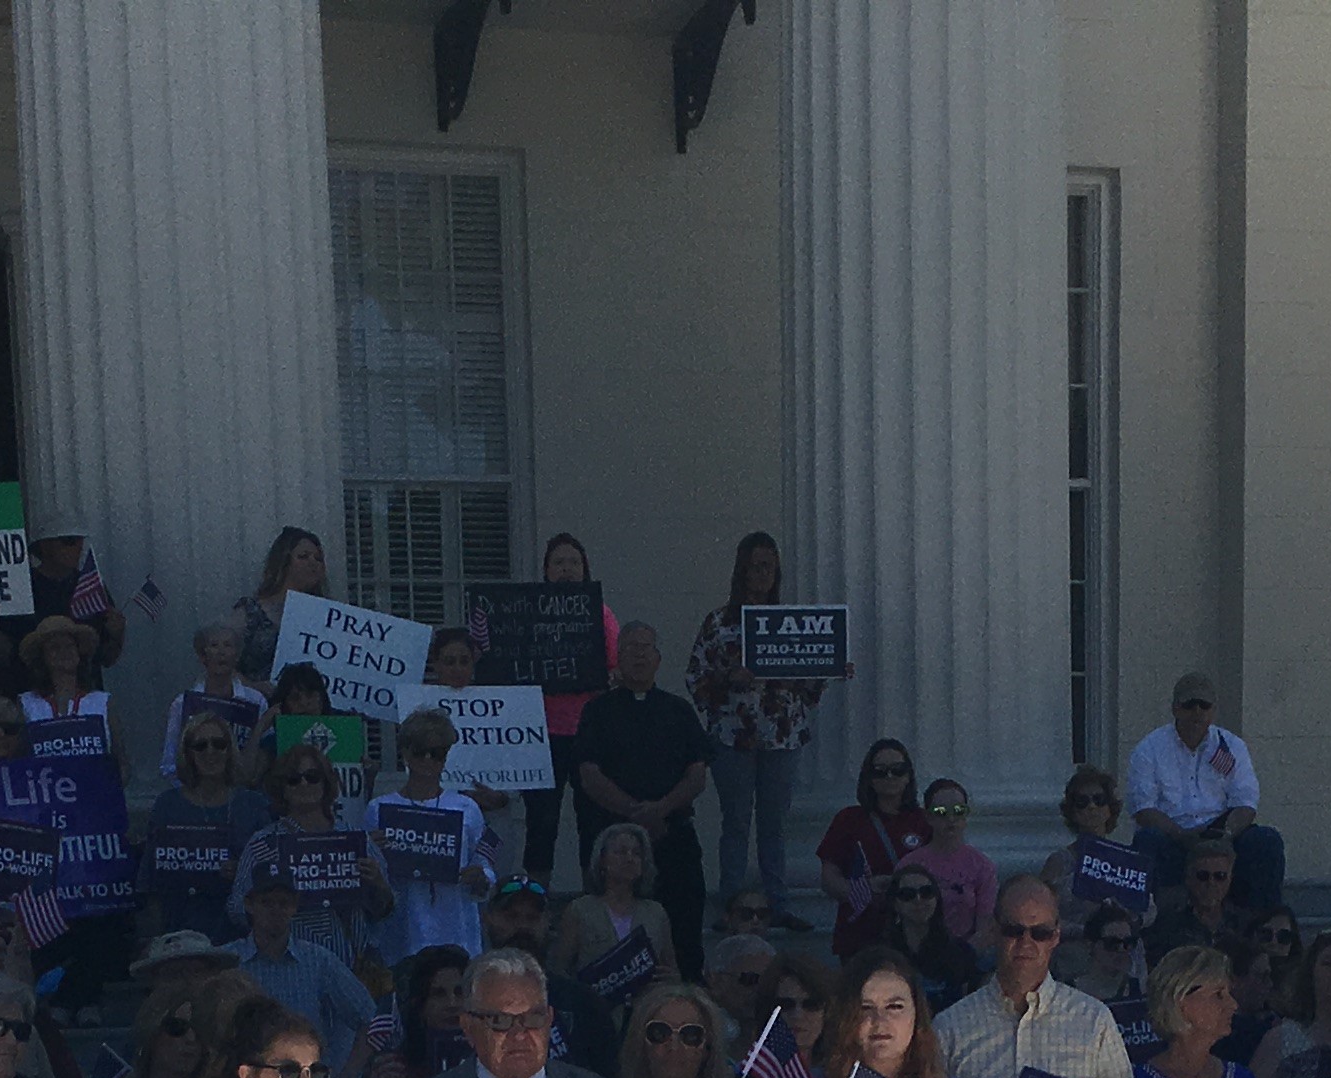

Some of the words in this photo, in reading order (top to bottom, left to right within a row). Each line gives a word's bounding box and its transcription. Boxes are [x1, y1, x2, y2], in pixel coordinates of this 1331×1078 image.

[537, 594, 591, 616] CANCER
[324, 608, 393, 642] PRAY
[755, 616, 770, 635] I
[776, 615, 835, 635] AM
[299, 632, 338, 660] TO
[347, 644, 406, 677] END
[755, 643, 835, 655] PRO-LIFE
[755, 657, 835, 666] GENERATION
[274, 668, 398, 709] RTIO
[438, 699, 504, 717] STOP
[454, 726, 545, 745] RTION
[33, 736, 103, 756] PRO-LIFE
[514, 768, 547, 783] LIFE
[0, 766, 78, 806] Life
[52, 810, 68, 829] is
[385, 827, 457, 847] PRO-LIFE
[58, 833, 128, 863] TIFUL
[155, 848, 230, 862] PRO-LIFE
[300, 852, 324, 864] AM
[330, 851, 357, 862] THE
[384, 840, 456, 857] PRO-WOMAN
[155, 860, 221, 872] PRO-WOMA
[1082, 855, 1148, 883] PRO-LIFE
[292, 878, 361, 891] ENERATION
[1081, 866, 1147, 893] PRO-WOMAN
[56, 884, 85, 899] ALK
[88, 883, 109, 898] TO
[112, 881, 134, 897] US
